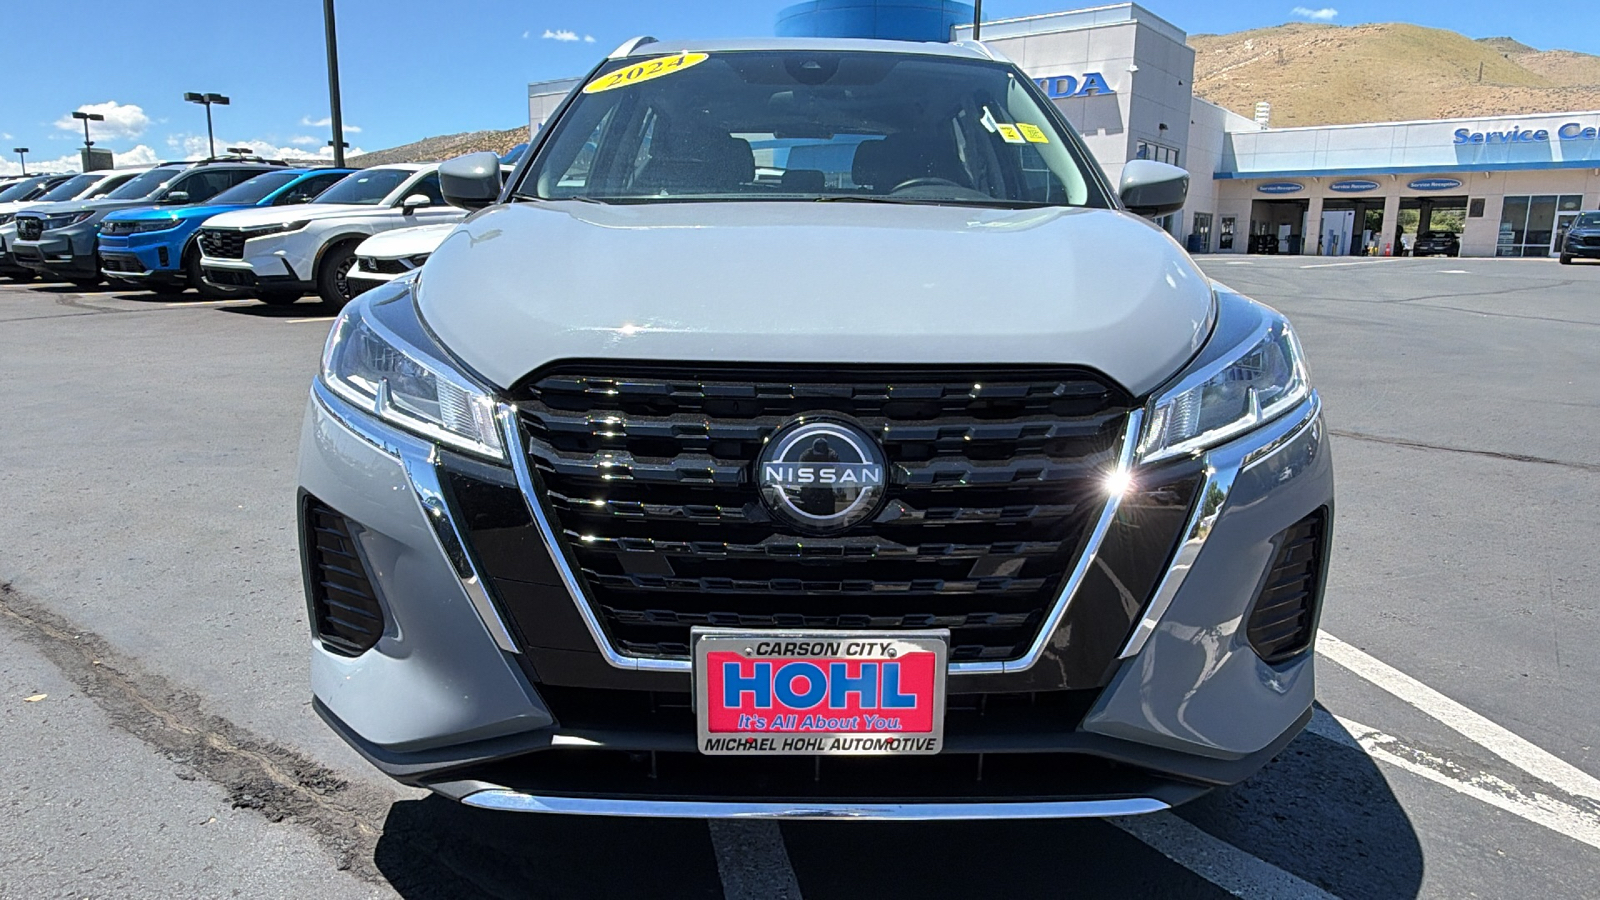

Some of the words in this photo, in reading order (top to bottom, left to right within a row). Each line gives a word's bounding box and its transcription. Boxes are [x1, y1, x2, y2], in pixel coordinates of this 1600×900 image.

[606, 56, 686, 88] 2024
[1453, 125, 1549, 145] Service
[1557, 122, 1600, 140] Ce
[765, 466, 880, 483] NISSAN
[756, 642, 841, 656] CARSON
[846, 642, 891, 656] CITY
[723, 662, 917, 710] HOHL
[738, 713, 766, 729] It's
[770, 714, 796, 729] All
[800, 715, 859, 730] About
[865, 714, 903, 730] You.
[704, 738, 777, 751] MICHAEL
[781, 738, 826, 751] HOHL
[829, 738, 938, 751] AUTOMOTIVE
